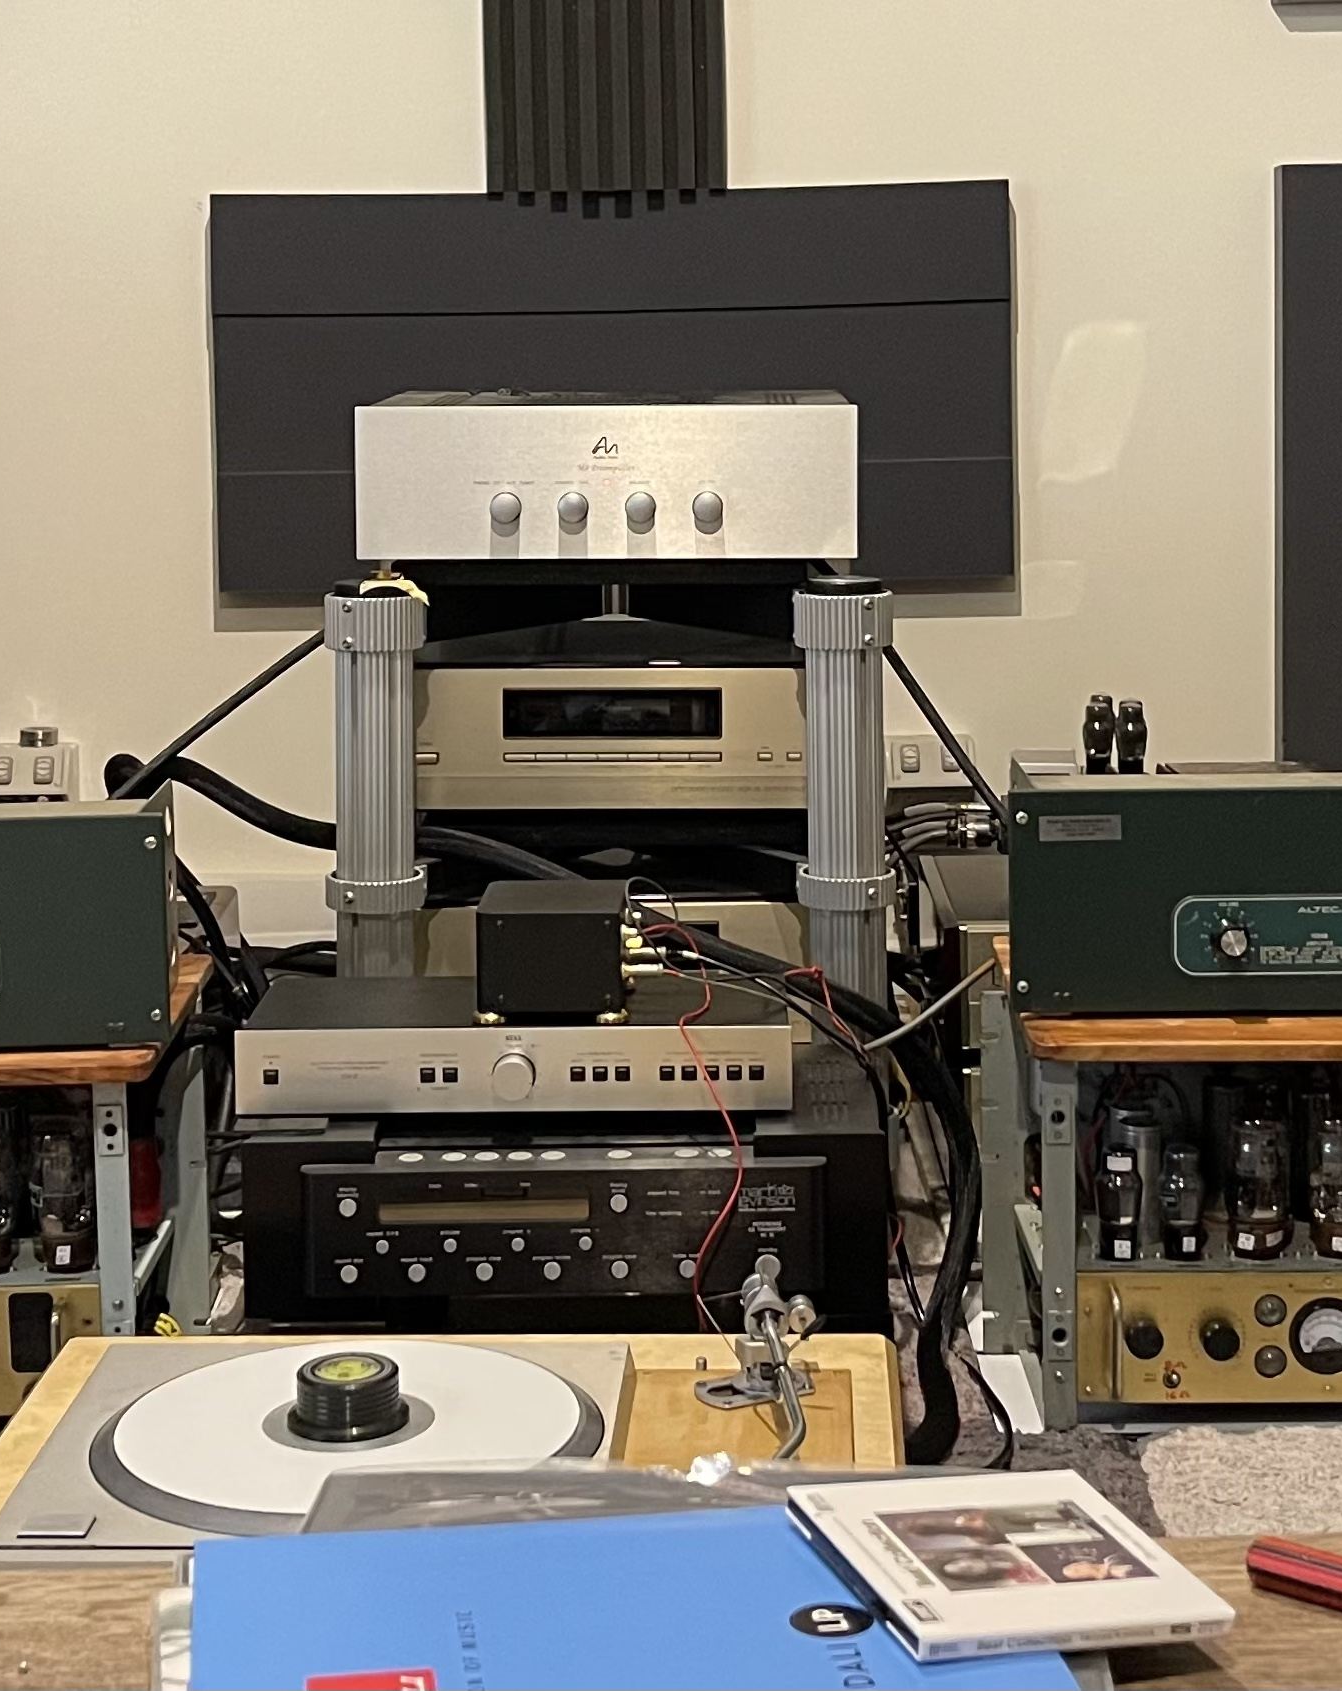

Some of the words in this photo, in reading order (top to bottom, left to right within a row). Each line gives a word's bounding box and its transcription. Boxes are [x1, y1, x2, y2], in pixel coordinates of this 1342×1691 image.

[1297, 905, 1342, 914] ALTEC
[811, 1608, 850, 1633] LP
[826, 1642, 876, 1689] DALI
